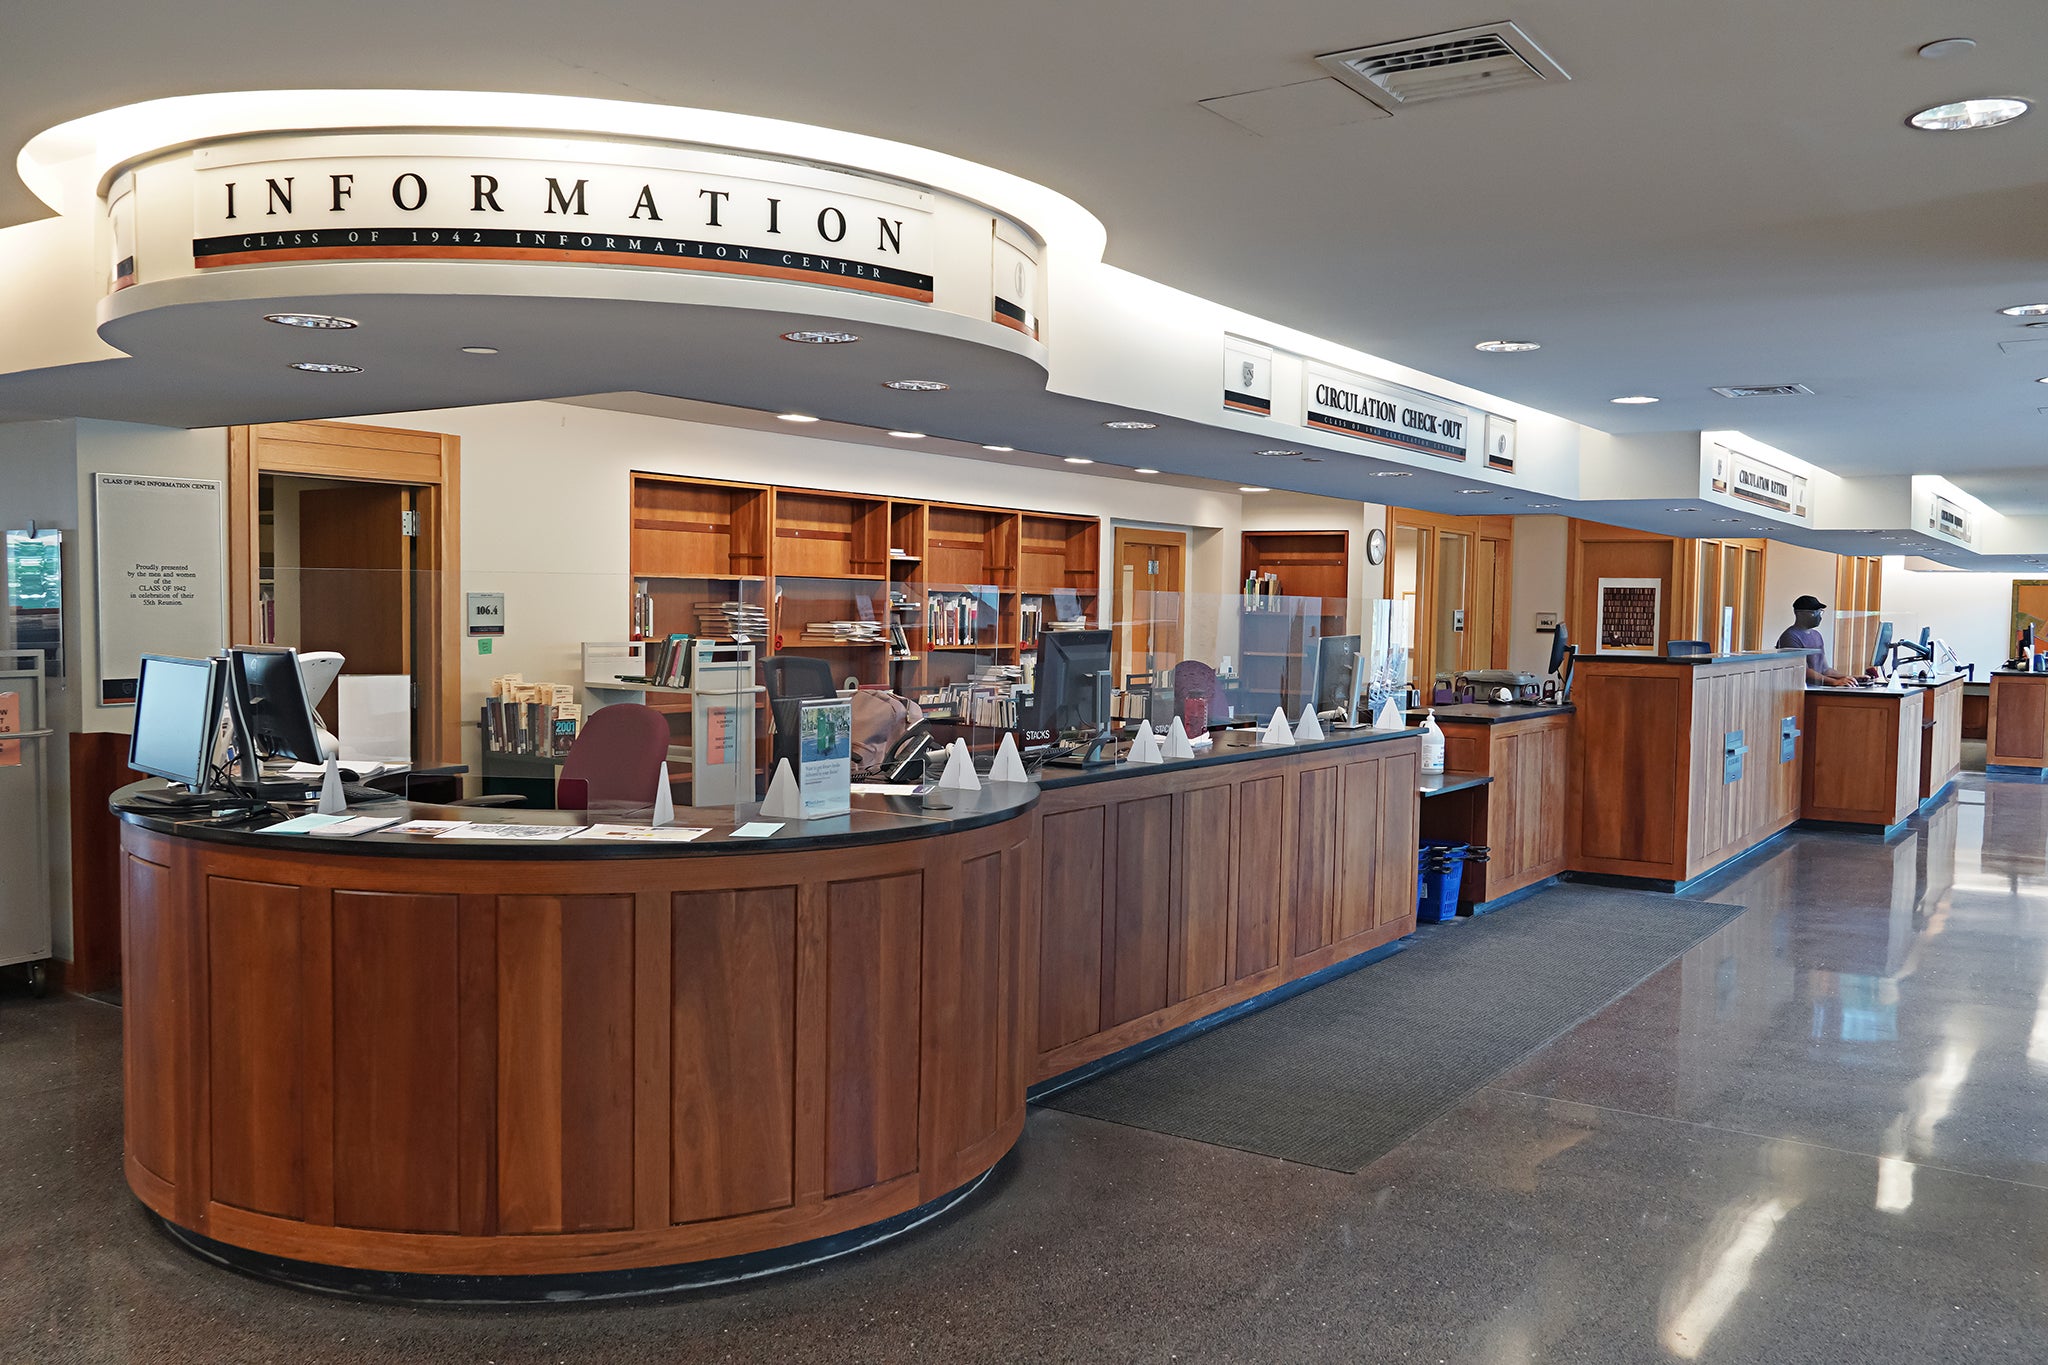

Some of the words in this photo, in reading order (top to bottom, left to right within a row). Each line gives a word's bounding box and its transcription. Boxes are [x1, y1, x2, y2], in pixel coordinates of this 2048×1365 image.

[225, 172, 903, 255] INFORMATION
[243, 231, 319, 248] CLASS
[348, 231, 380, 243] OF
[412, 231, 483, 243] 1942
[515, 232, 750, 260] INFORMATION
[782, 254, 881, 279] CENTER
[1316, 383, 1397, 423] CIRCULATION
[1402, 408, 1463, 440] CHECK-OUT
[1324, 416, 1347, 428] CLASS
[147, 481, 191, 489] INFORMATION
[476, 604, 498, 615] 106.4
[555, 721, 576, 733] 2001
[1155, 724, 1170, 733] STAC
[1026, 730, 1050, 740] STACKS
